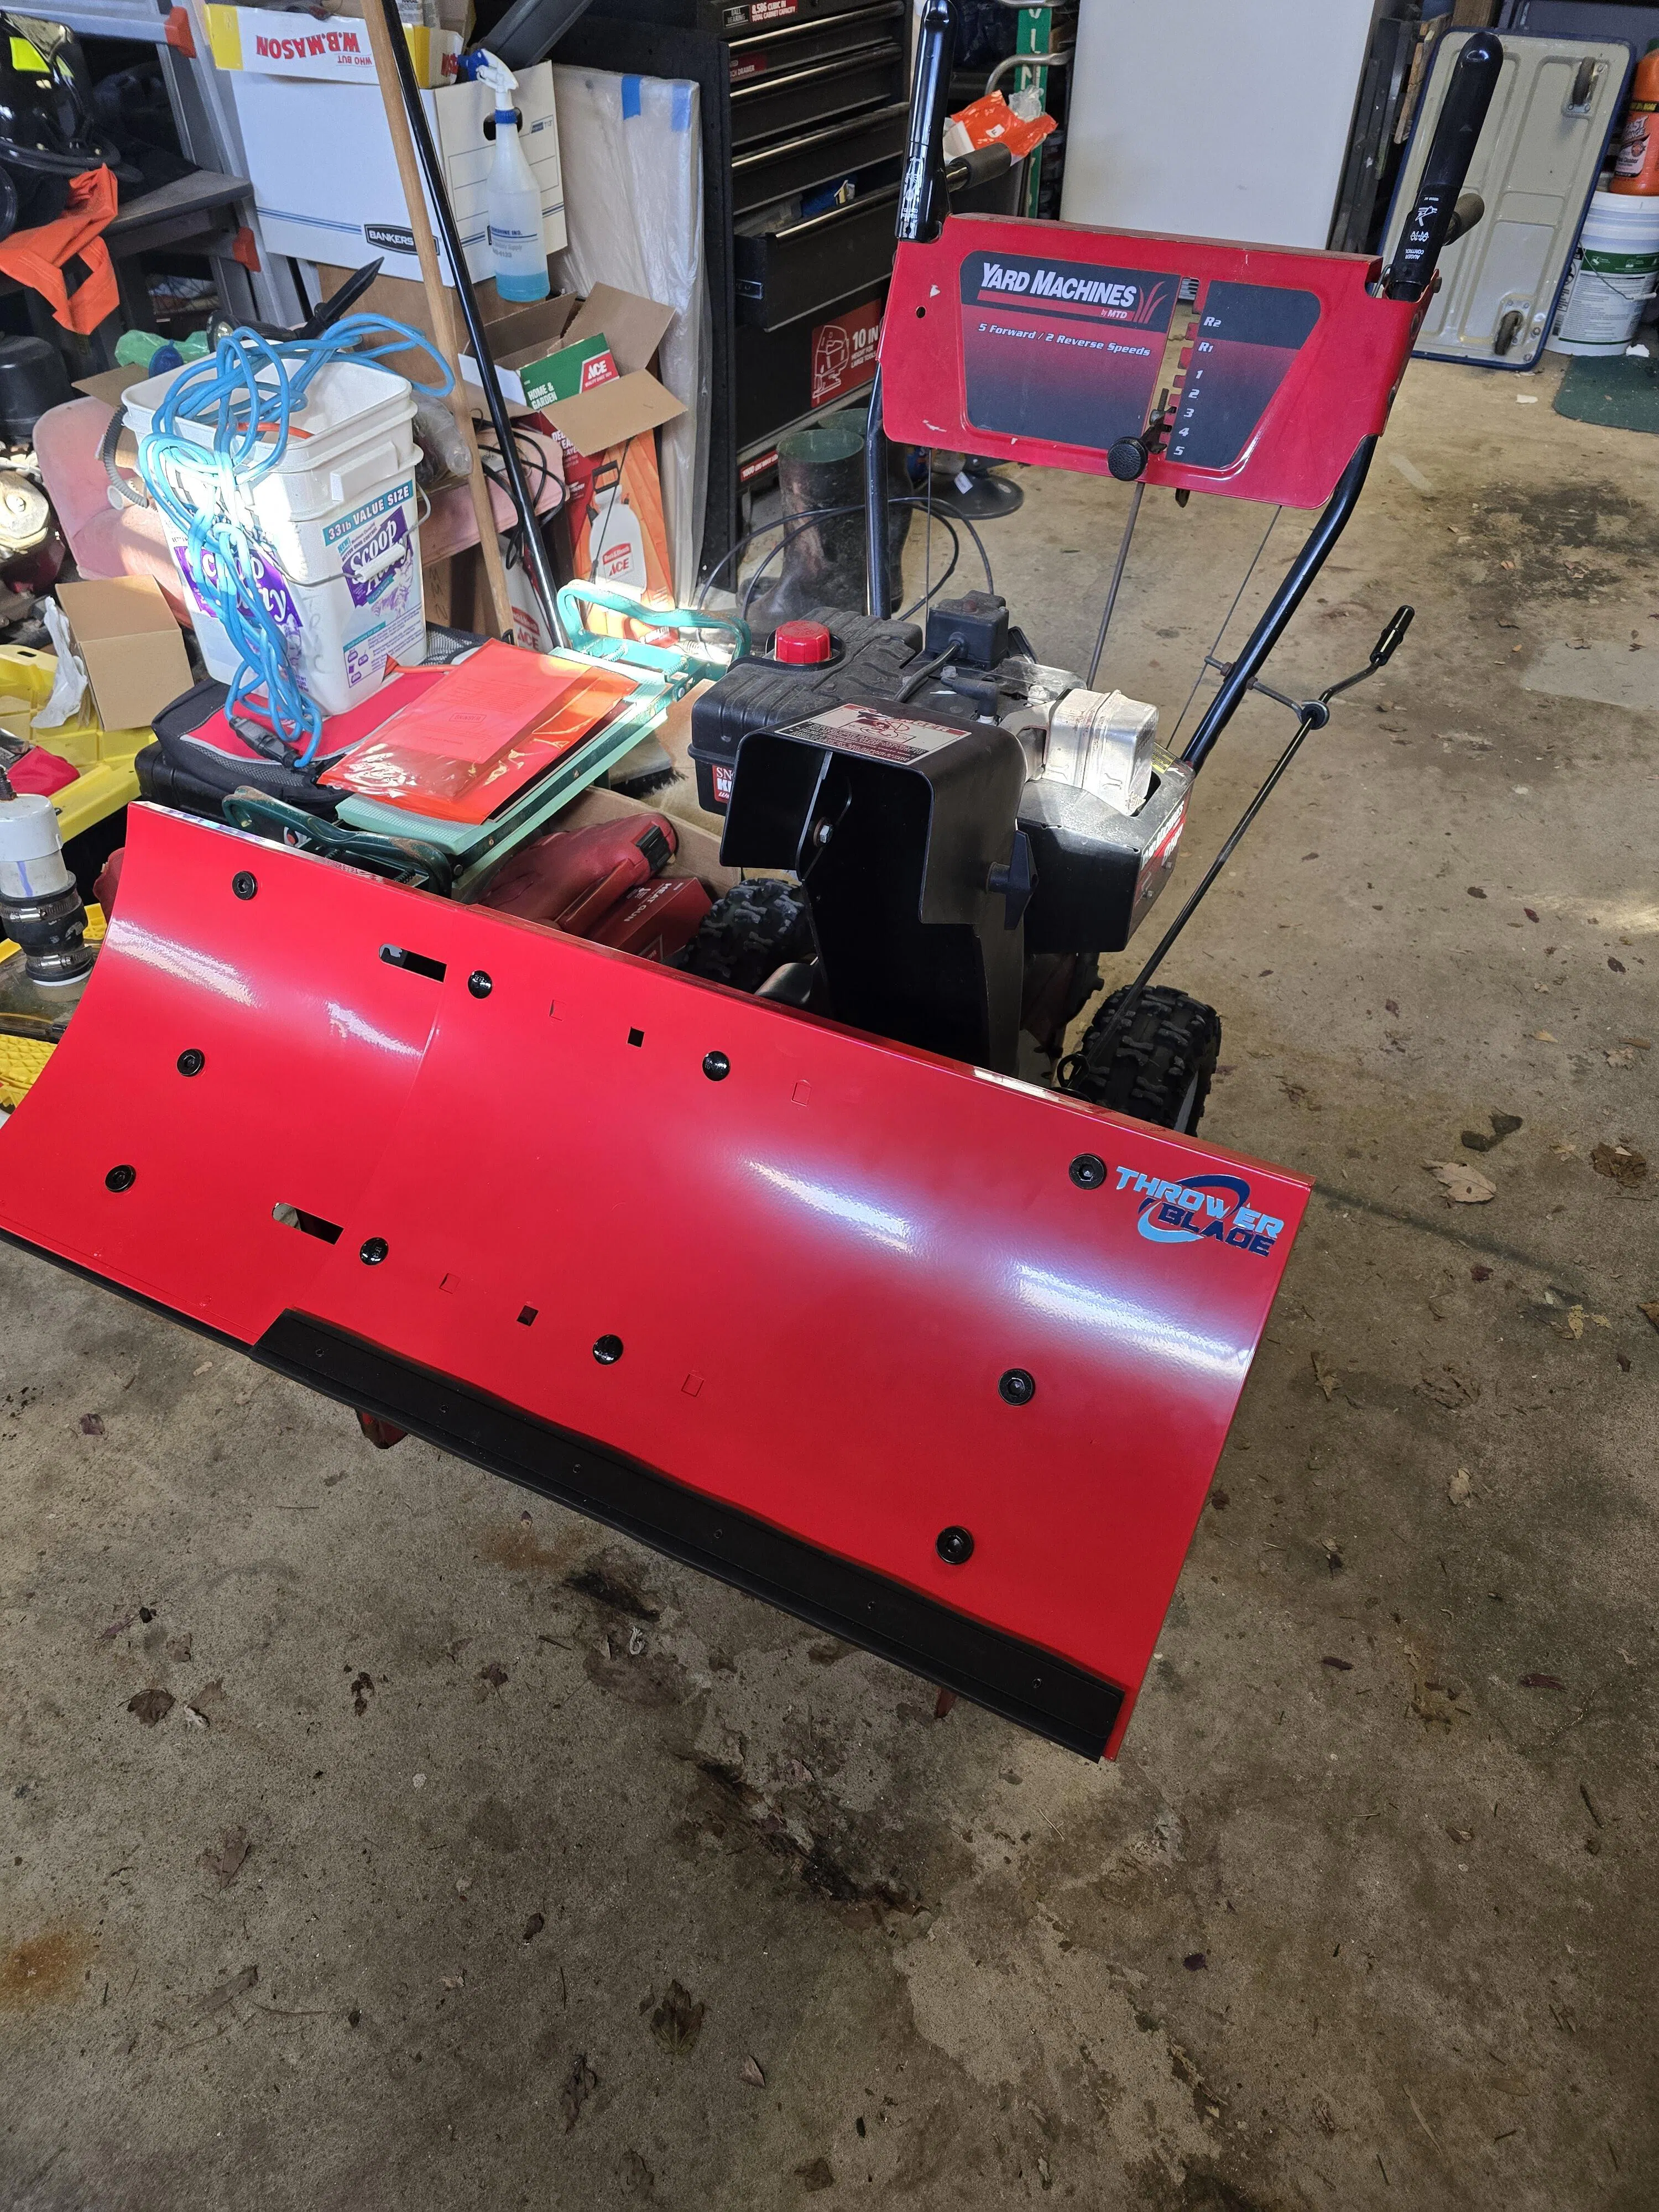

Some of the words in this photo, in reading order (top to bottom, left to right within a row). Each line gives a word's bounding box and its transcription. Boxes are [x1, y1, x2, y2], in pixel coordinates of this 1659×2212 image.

[768, 1, 781, 11] CUBIC
[255, 32, 361, 59] W.B.MASON
[337, 55, 352, 64] BUT
[354, 56, 372, 65] WHO
[369, 229, 414, 246] BANKERS
[981, 262, 1030, 293] YARD
[1030, 269, 1137, 308] MACHINES
[1100, 309, 1107, 317] by
[1107, 309, 1128, 320] MTD
[1203, 316, 1222, 328] R2
[852, 328, 867, 351] 10
[868, 325, 879, 345] IN
[978, 323, 988, 332] 5
[989, 325, 1036, 340] Forward
[1037, 332, 1044, 341] /
[1045, 333, 1055, 342] 2
[1056, 335, 1104, 350] Reverse
[1107, 342, 1151, 357] Speeds
[1198, 342, 1214, 353] R1
[588, 359, 608, 380] ACE
[1195, 370, 1203, 379] 1
[527, 384, 548, 401] HOME
[547, 382, 555, 392] &
[531, 391, 558, 410] GARDEN
[1188, 389, 1200, 399] 2
[1183, 408, 1194, 418] 3
[1178, 427, 1190, 437] 4
[1173, 446, 1185, 456] 5
[353, 499, 384, 525] VALUE
[387, 486, 409, 506] SIZE
[609, 557, 629, 576] ACE
[517, 628, 539, 651] ACE
[717, 778, 732, 793] KI
[646, 883, 672, 904] HEAT
[1116, 1166, 1285, 1239] THROWER
[1158, 1202, 1277, 1258] BLADE
